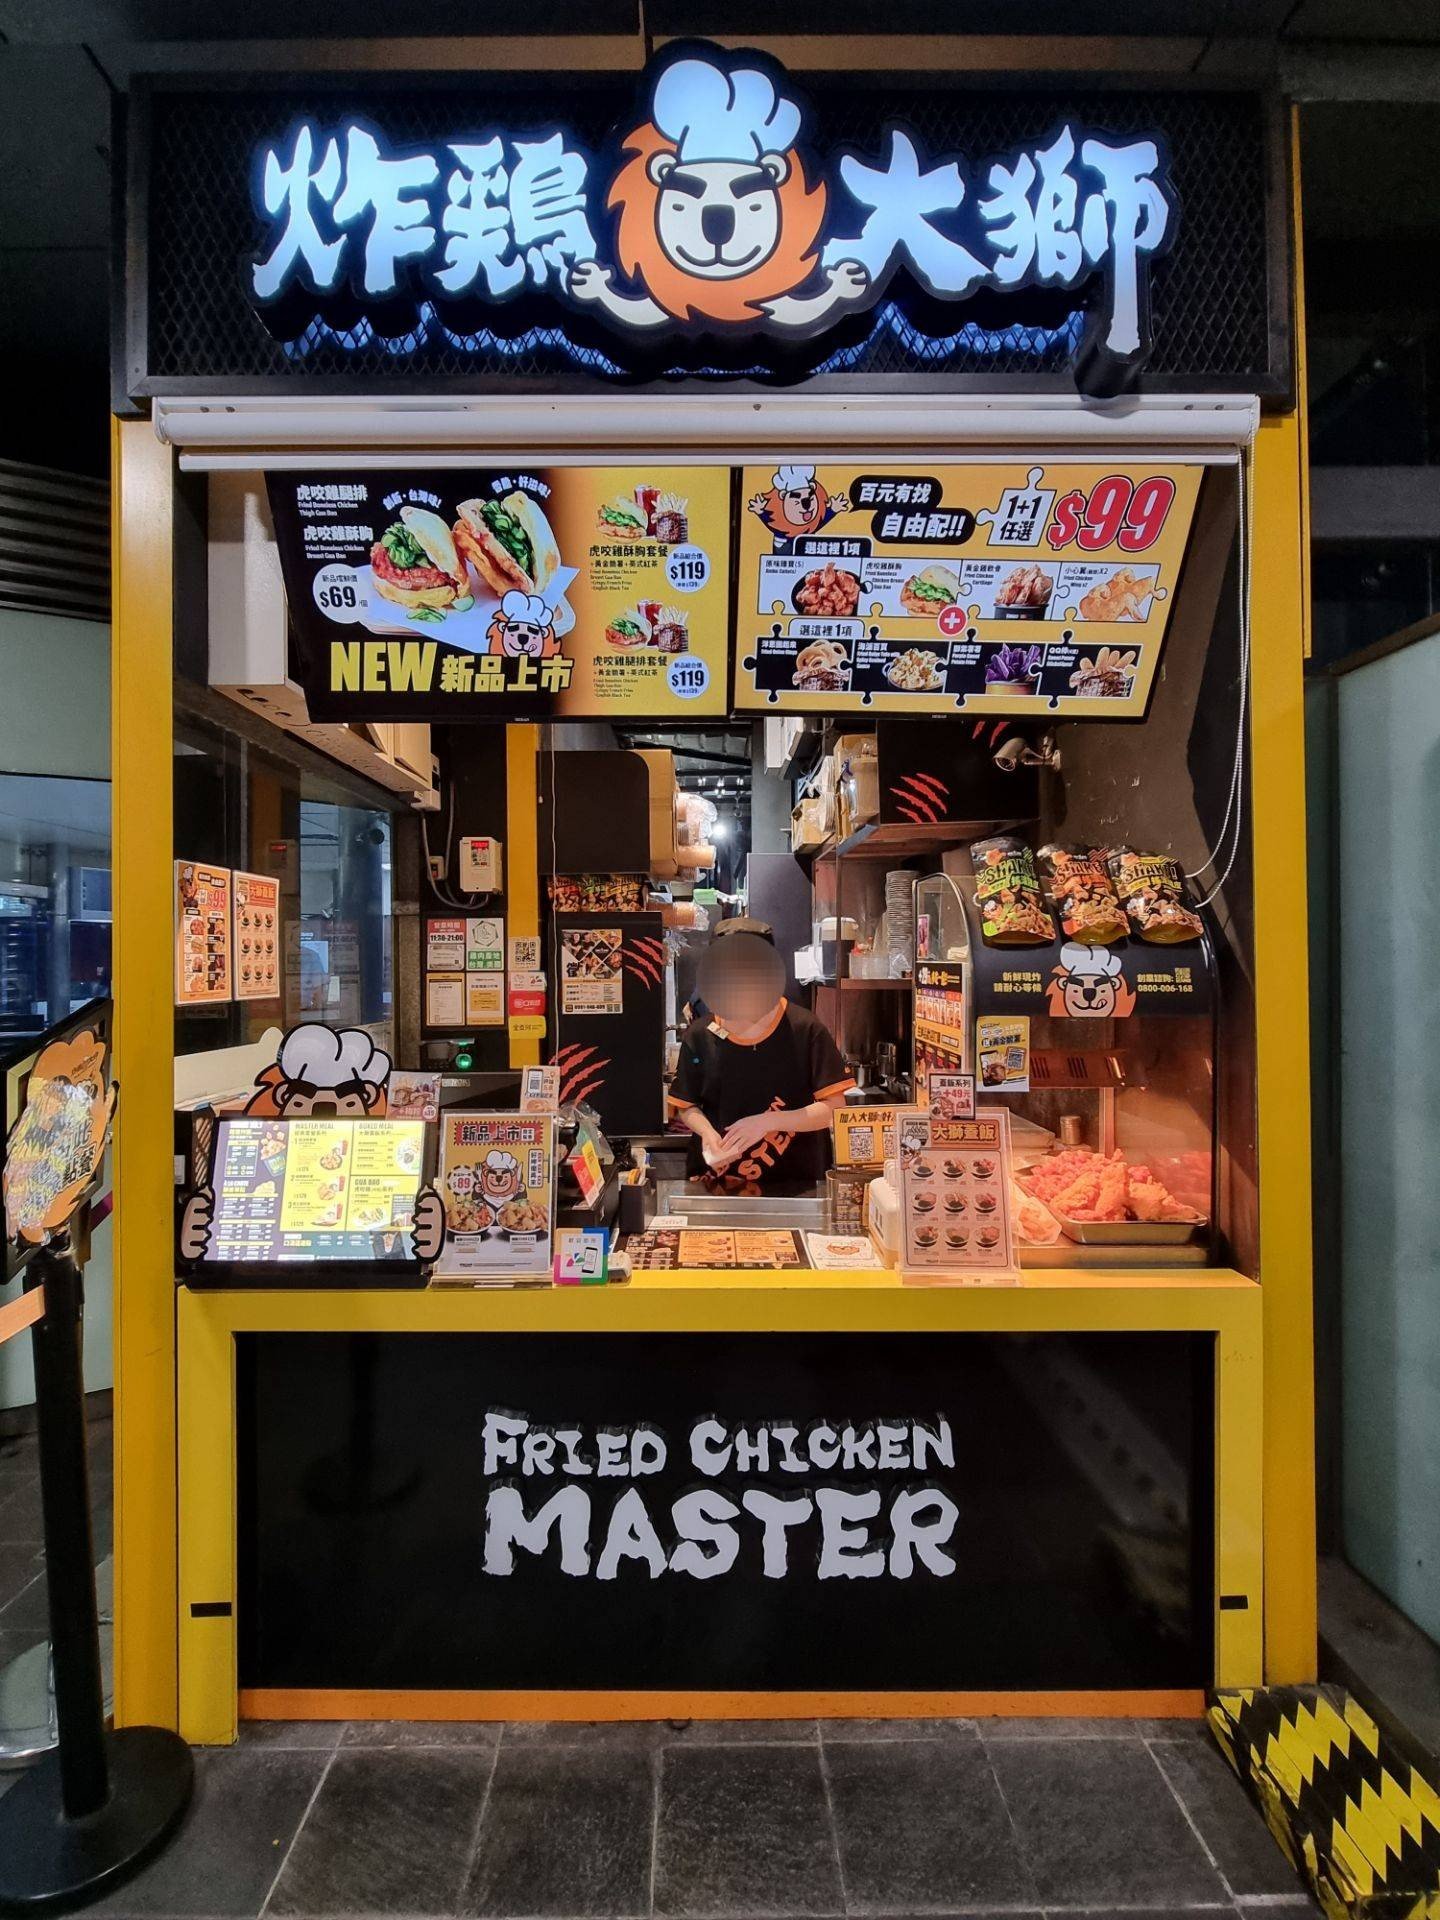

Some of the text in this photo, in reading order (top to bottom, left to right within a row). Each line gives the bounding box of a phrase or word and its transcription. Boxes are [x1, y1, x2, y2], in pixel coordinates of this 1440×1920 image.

[859, 482, 932, 504] 百元有找
[1006, 494, 1043, 520] 1+1
[1047, 474, 1177, 552] $99
[881, 512, 966, 539] 自由配!!
[1000, 520, 1035, 542] 任選
[671, 562, 705, 580] $119
[320, 586, 356, 608] $69
[800, 624, 852, 637] 選這裡1項
[330, 641, 437, 692] NEW
[440, 654, 573, 693] 新品上市
[672, 670, 704, 687] $119
[1002, 971, 1042, 982] 新鮮現炸
[463, 1124, 520, 1142] 新品上市
[933, 1123, 996, 1141] 大獅蓋飯
[482, 1413, 956, 1477] FRIED CHICKEN
[482, 1485, 960, 1580] MASTER
